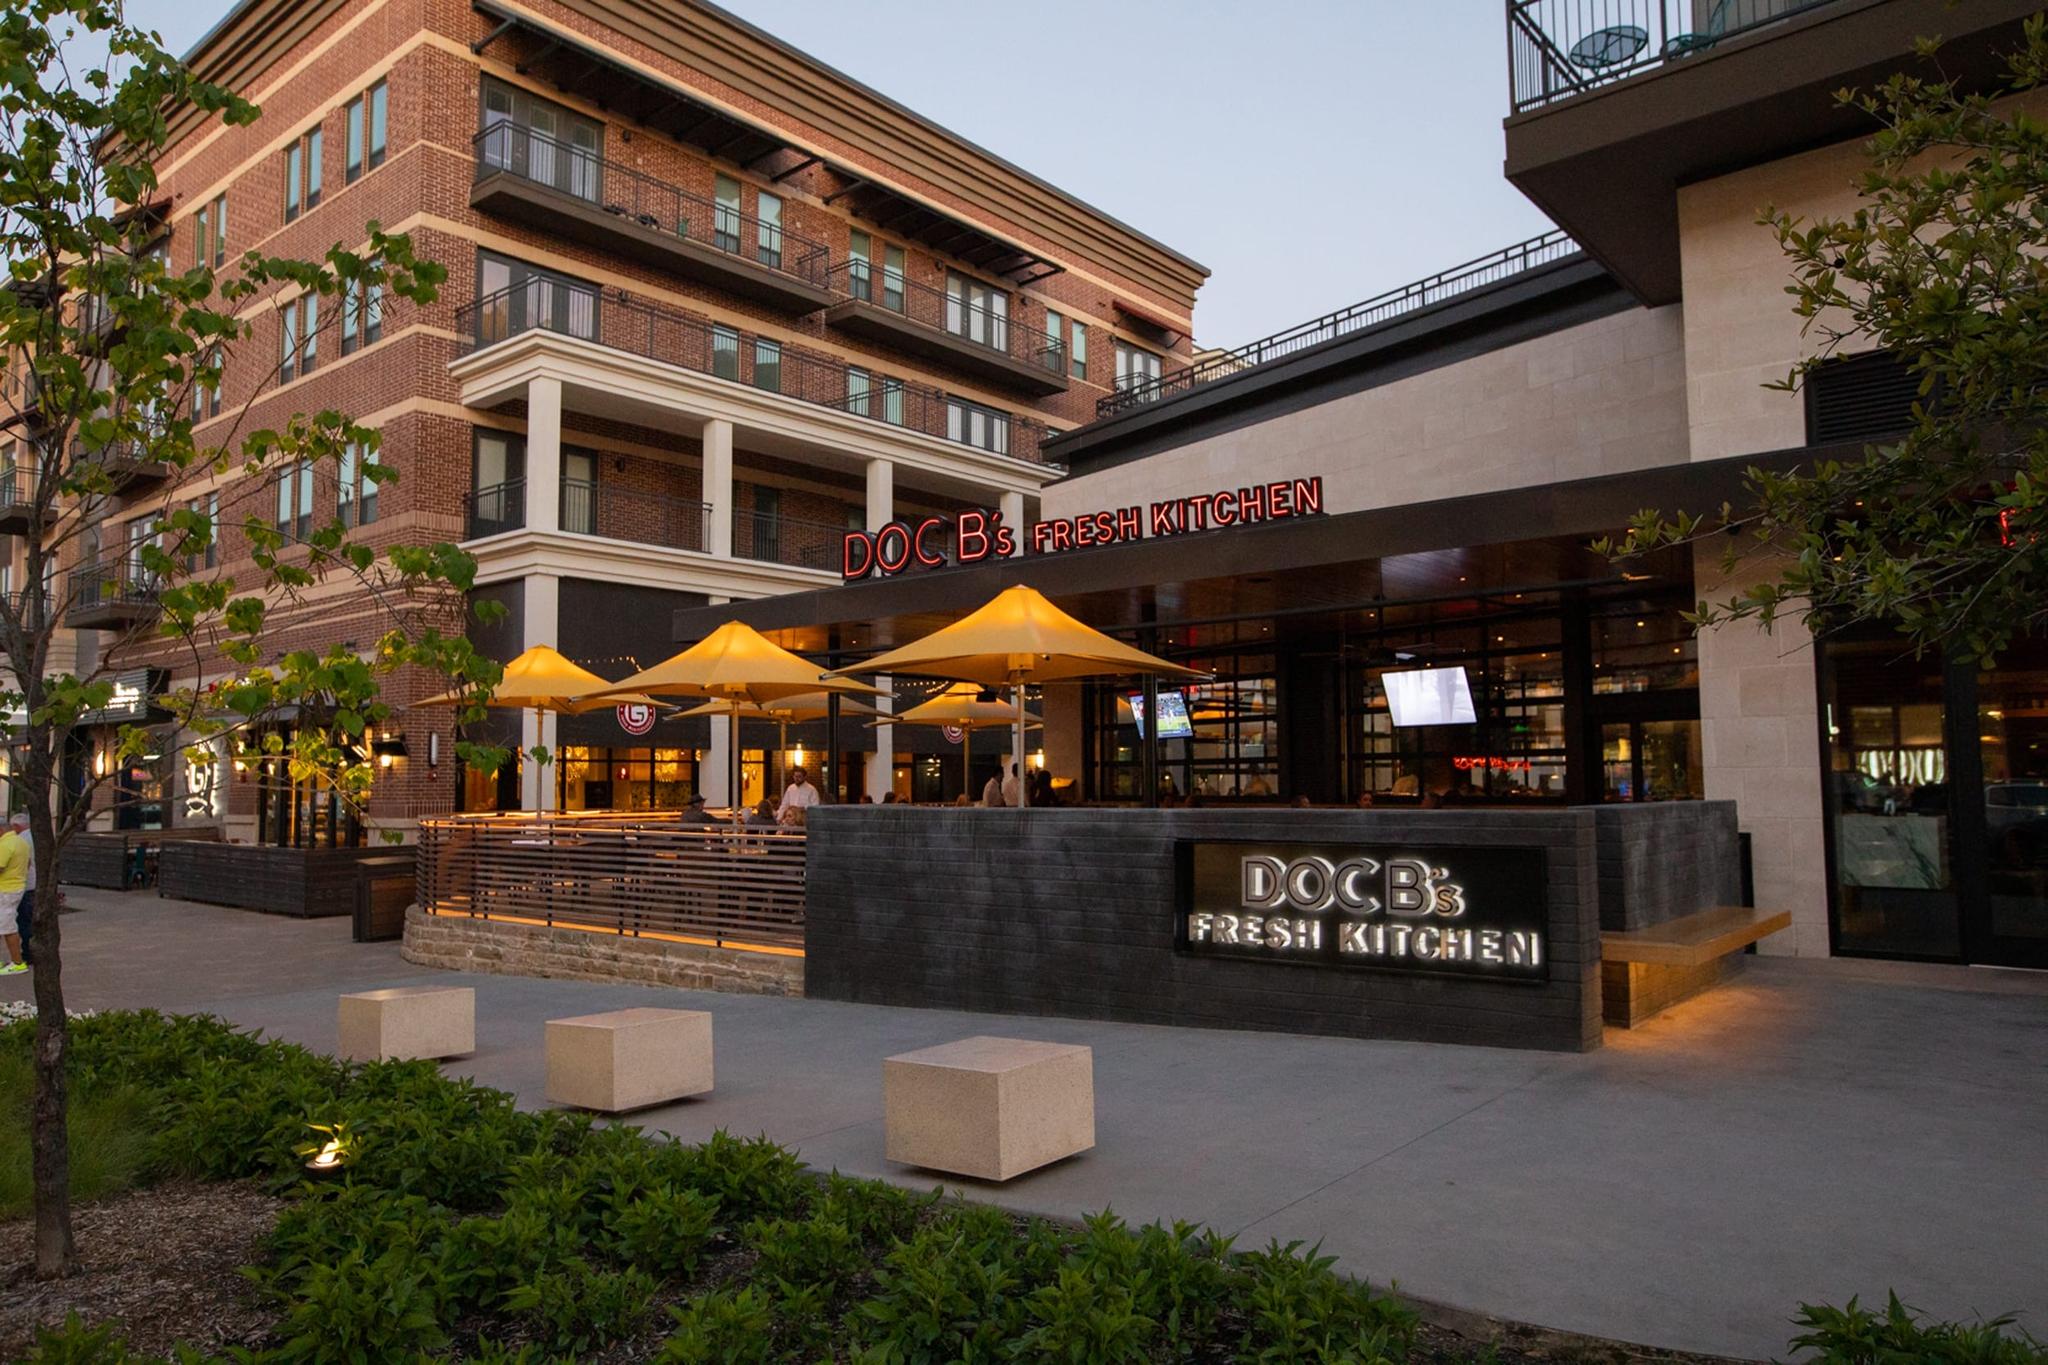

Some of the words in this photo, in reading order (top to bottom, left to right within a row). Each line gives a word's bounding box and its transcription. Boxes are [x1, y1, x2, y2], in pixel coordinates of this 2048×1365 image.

[843, 515, 948, 580] DOC
[957, 508, 1016, 563] B's
[1033, 506, 1142, 553] FRESH
[1151, 476, 1322, 536] KITCHEN
[1241, 855, 1381, 914] DOC
[1385, 859, 1467, 918] B's
[1188, 913, 1322, 950] FRESH
[1338, 921, 1541, 967] KITCHEN
